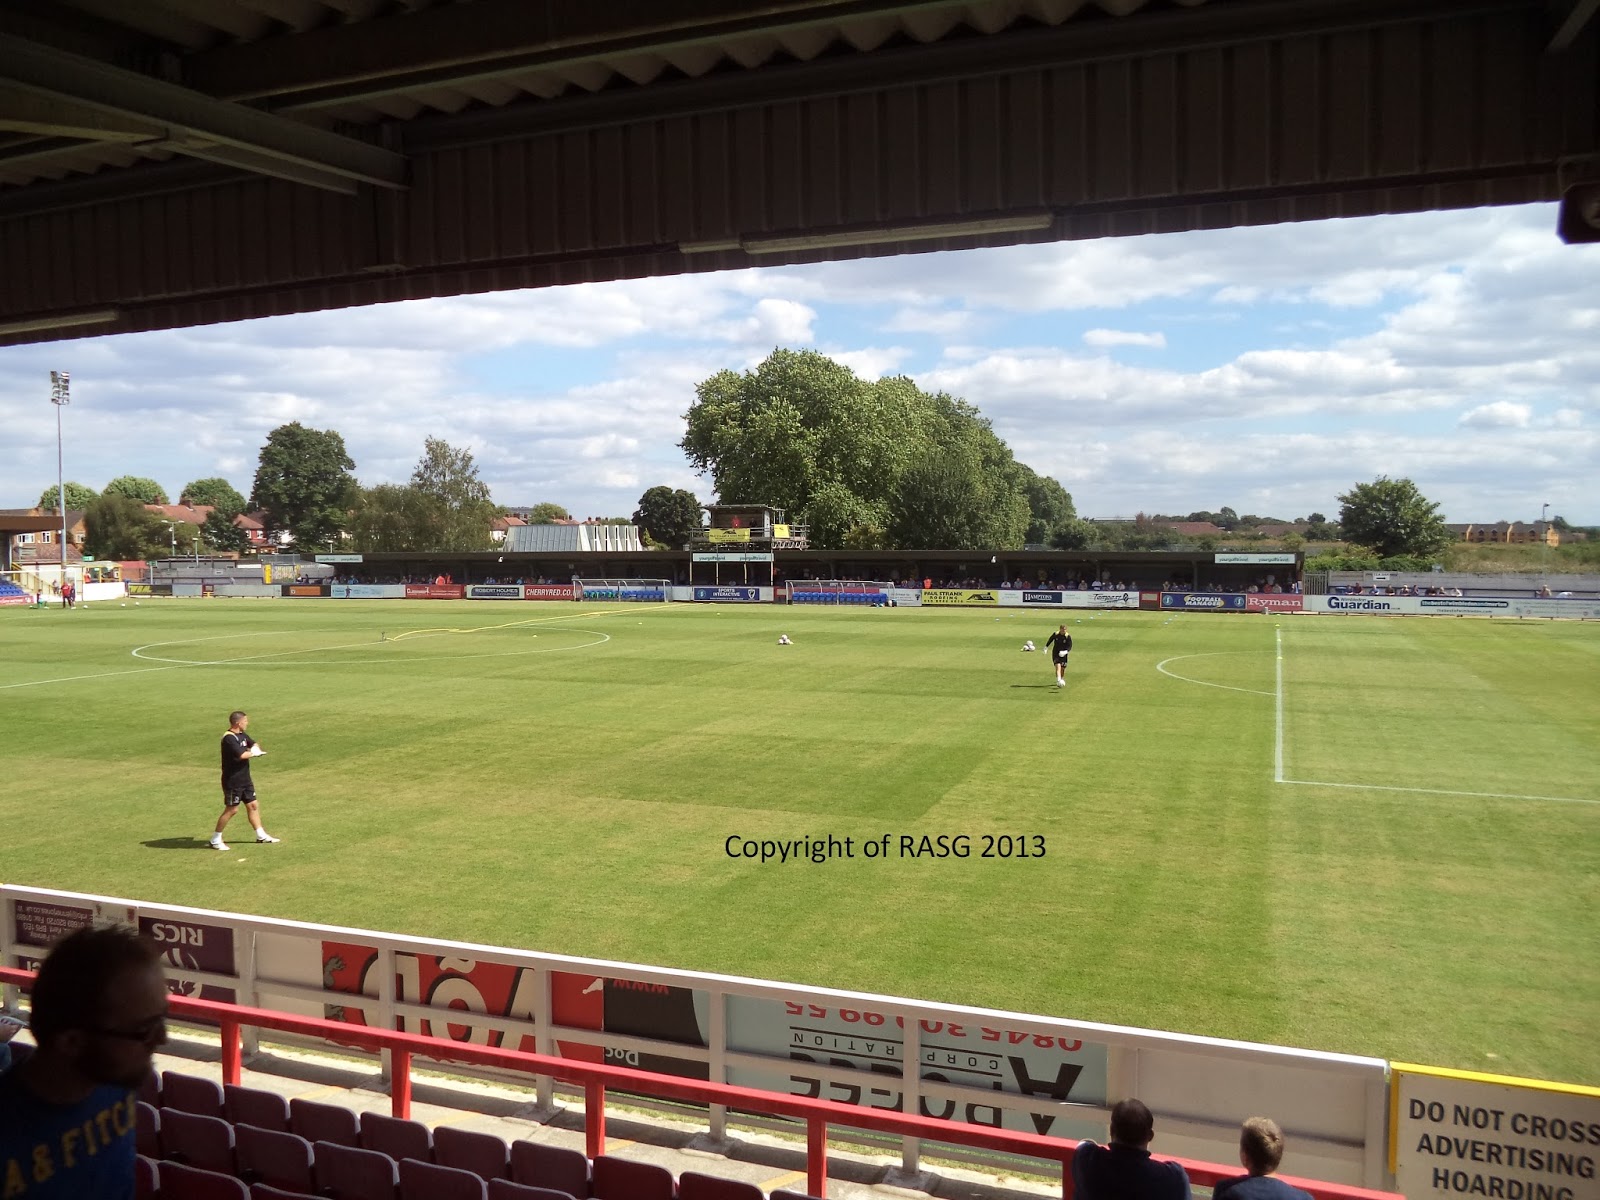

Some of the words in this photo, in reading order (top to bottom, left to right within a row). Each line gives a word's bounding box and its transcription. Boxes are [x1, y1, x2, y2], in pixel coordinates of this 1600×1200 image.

[1248, 597, 1302, 608] Ryman
[1327, 596, 1390, 610] Guardian
[152, 923, 203, 946] RICS
[794, 1033, 999, 1069] CORPRATION
[1409, 1098, 1445, 1123] DO
[1453, 1104, 1504, 1131] NOT
[1510, 1112, 1600, 1146] CROSS
[1416, 1132, 1595, 1180] ADVERTISING
[1432, 1167, 1575, 1200] HOARDING
